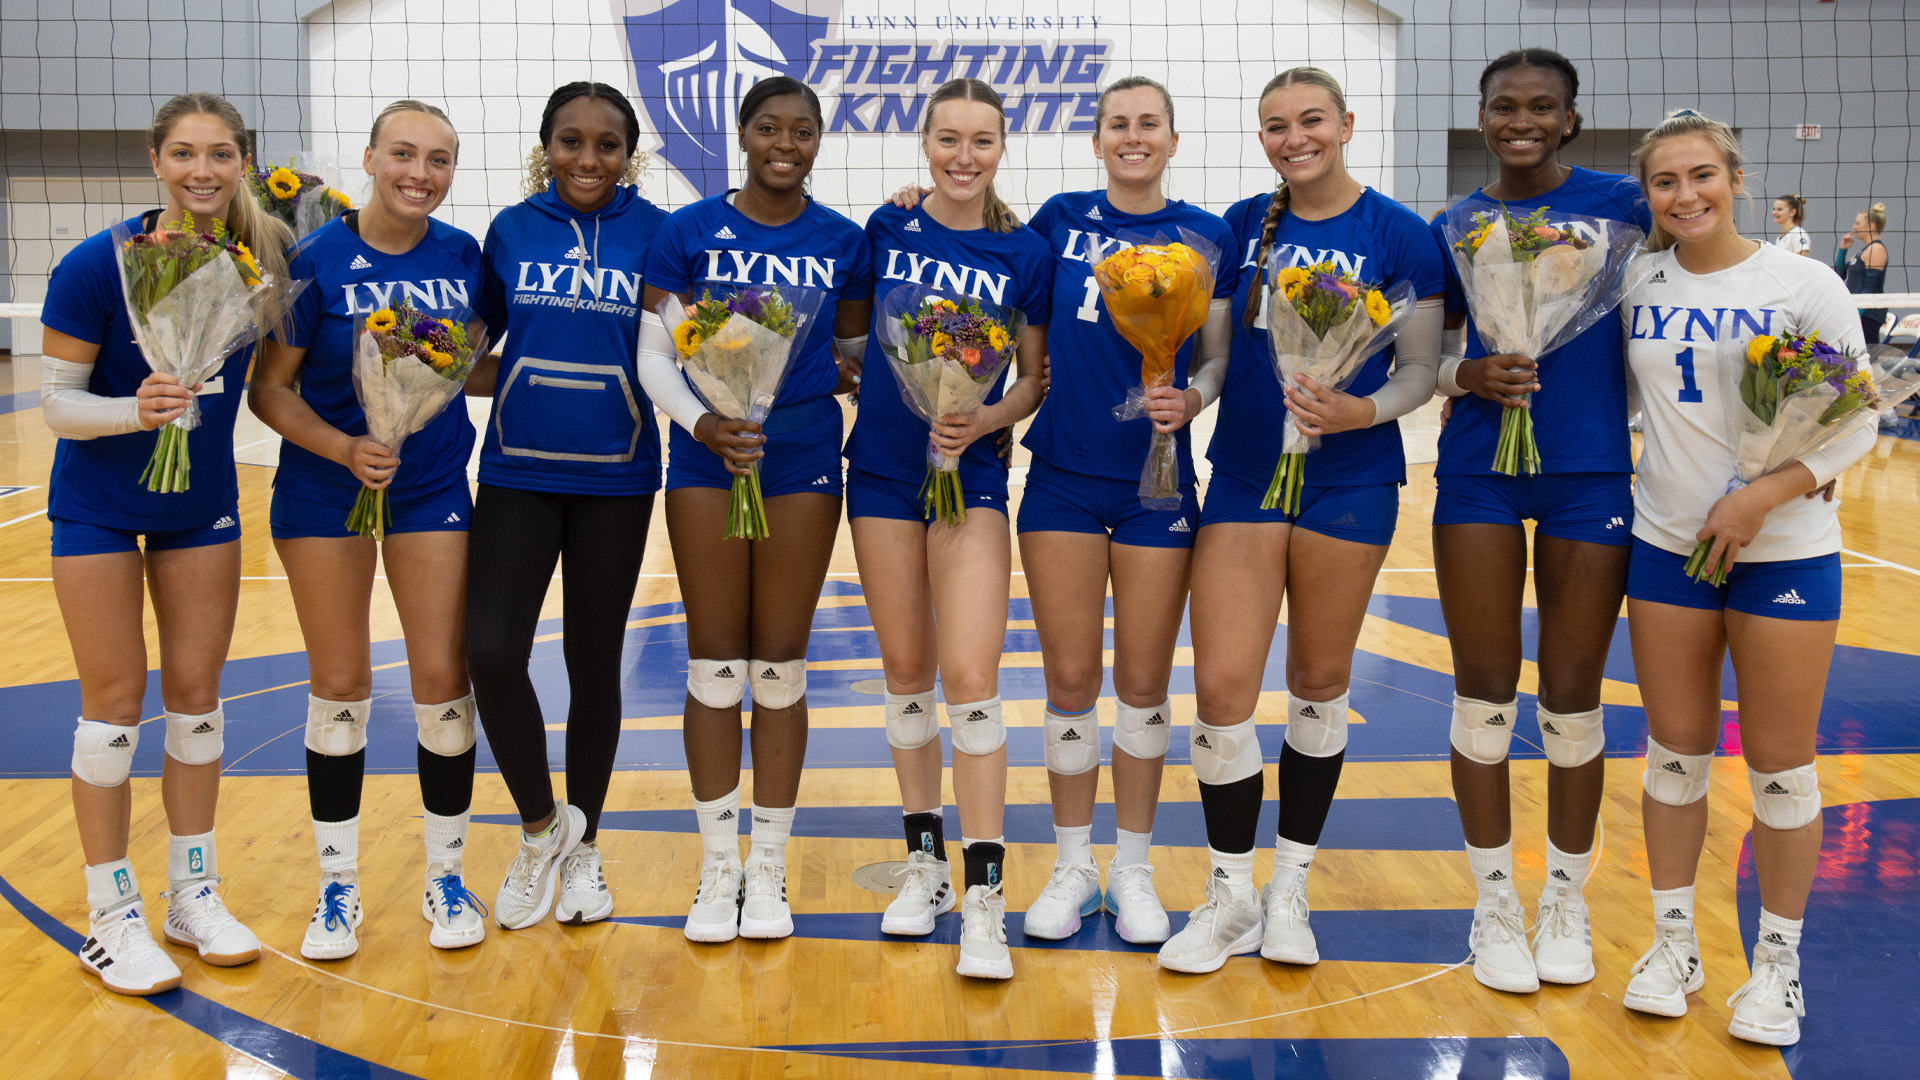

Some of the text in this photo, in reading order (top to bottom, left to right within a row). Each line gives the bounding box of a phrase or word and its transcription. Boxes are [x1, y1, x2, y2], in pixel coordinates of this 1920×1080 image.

[850, 16, 1103, 30] LYNN UNIVERSITY
[808, 44, 1107, 84] FIGHTING
[828, 92, 1097, 132] KNHTS
[1802, 126, 1818, 138] EXIT
[515, 261, 643, 305] LYNN
[704, 250, 836, 289] LYNN
[882, 249, 1010, 306] LYNN
[341, 278, 469, 316] LYNN
[513, 294, 637, 317] FIGHTING KNIGHTS
[1630, 305, 1776, 342] LYNN
[1676, 347, 1703, 403] 1
